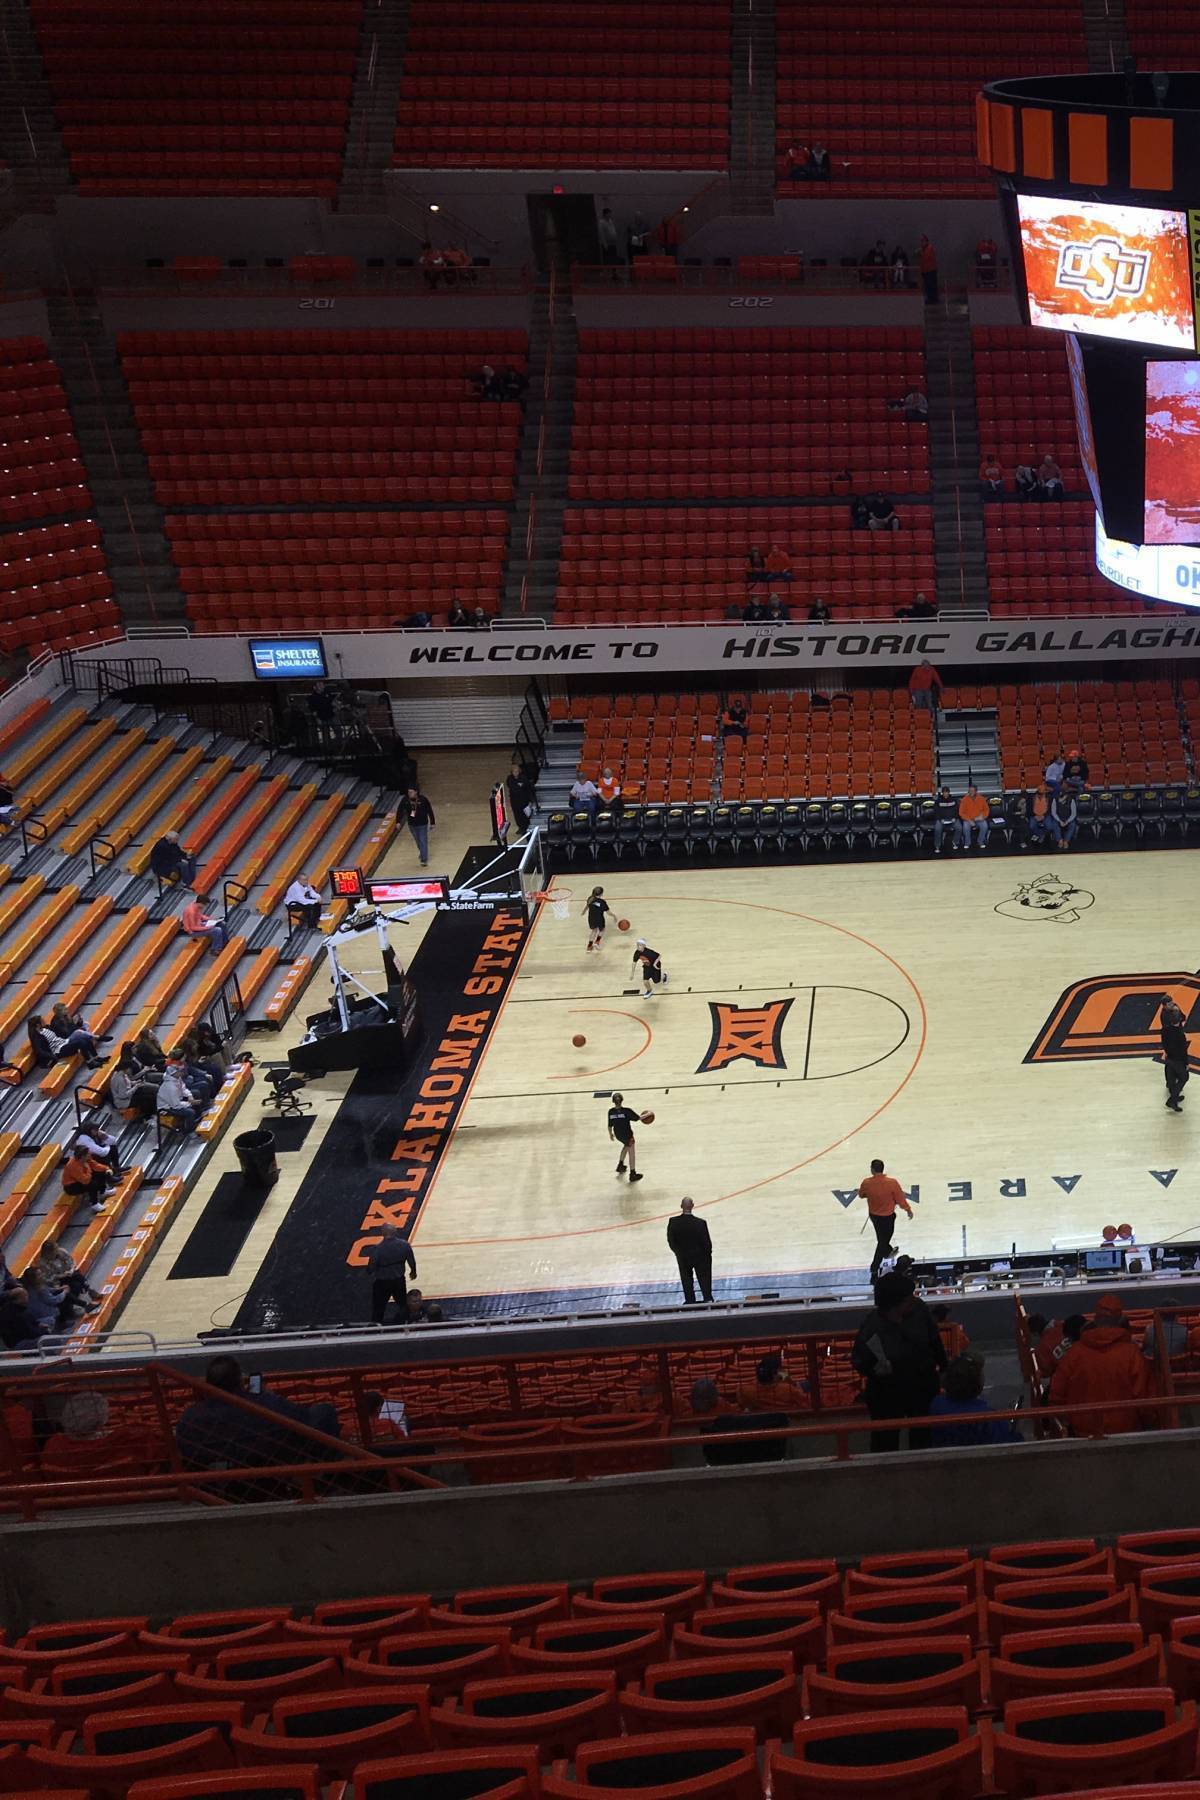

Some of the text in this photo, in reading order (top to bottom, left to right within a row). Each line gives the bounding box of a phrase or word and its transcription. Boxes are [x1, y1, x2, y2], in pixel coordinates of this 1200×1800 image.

[1055, 234, 1152, 305] OSU
[298, 297, 336, 310] 201
[728, 296, 774, 308] 202
[275, 649, 319, 660] SHELTER
[409, 641, 659, 664] WELCOME TO
[722, 633, 950, 659] HISTORIC
[277, 659, 321, 667] INSURANCE
[463, 908, 525, 997] STAT
